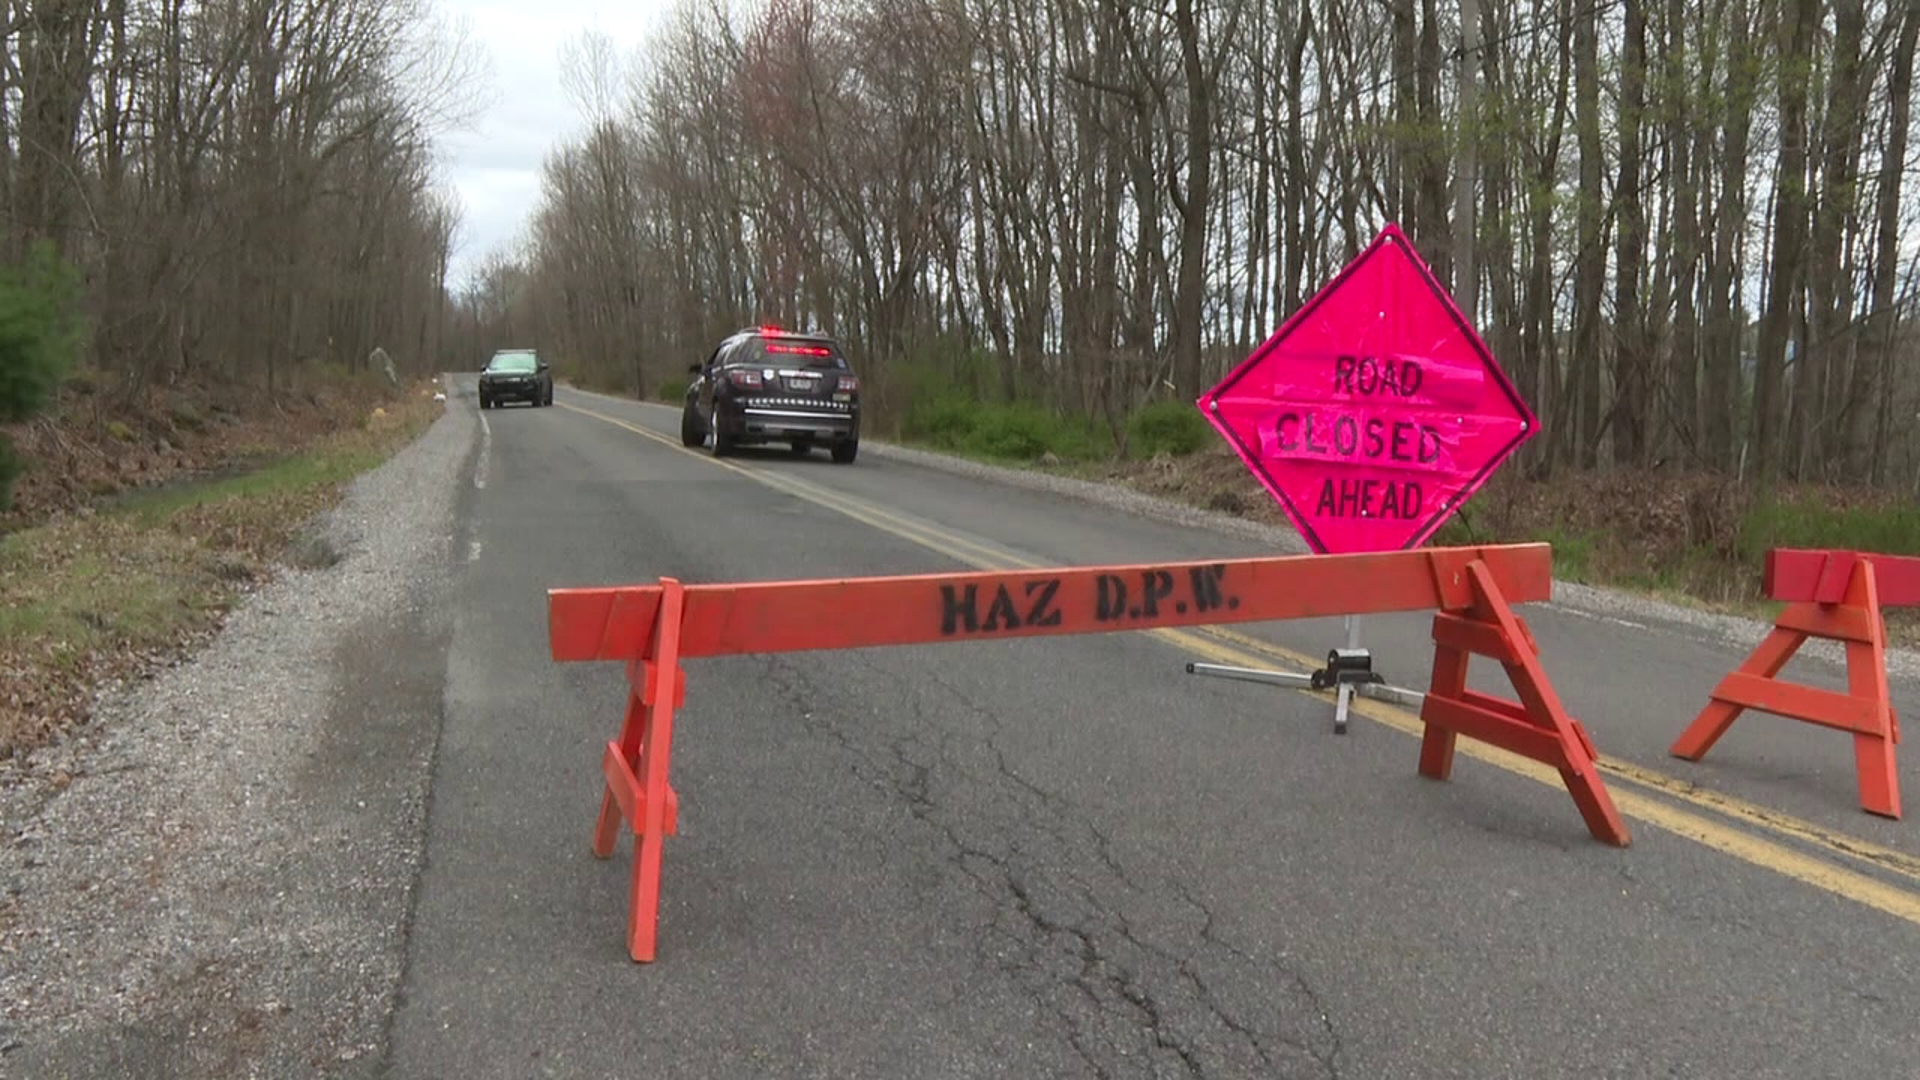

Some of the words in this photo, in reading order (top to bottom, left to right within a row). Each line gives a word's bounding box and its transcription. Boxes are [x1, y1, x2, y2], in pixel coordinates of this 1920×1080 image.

[1334, 356, 1422, 397] ROAD
[1275, 413, 1440, 463] CLOSED
[1315, 479, 1423, 520] AHEAD
[940, 579, 1061, 635] HAZ
[1095, 564, 1240, 622] D.P.W.
